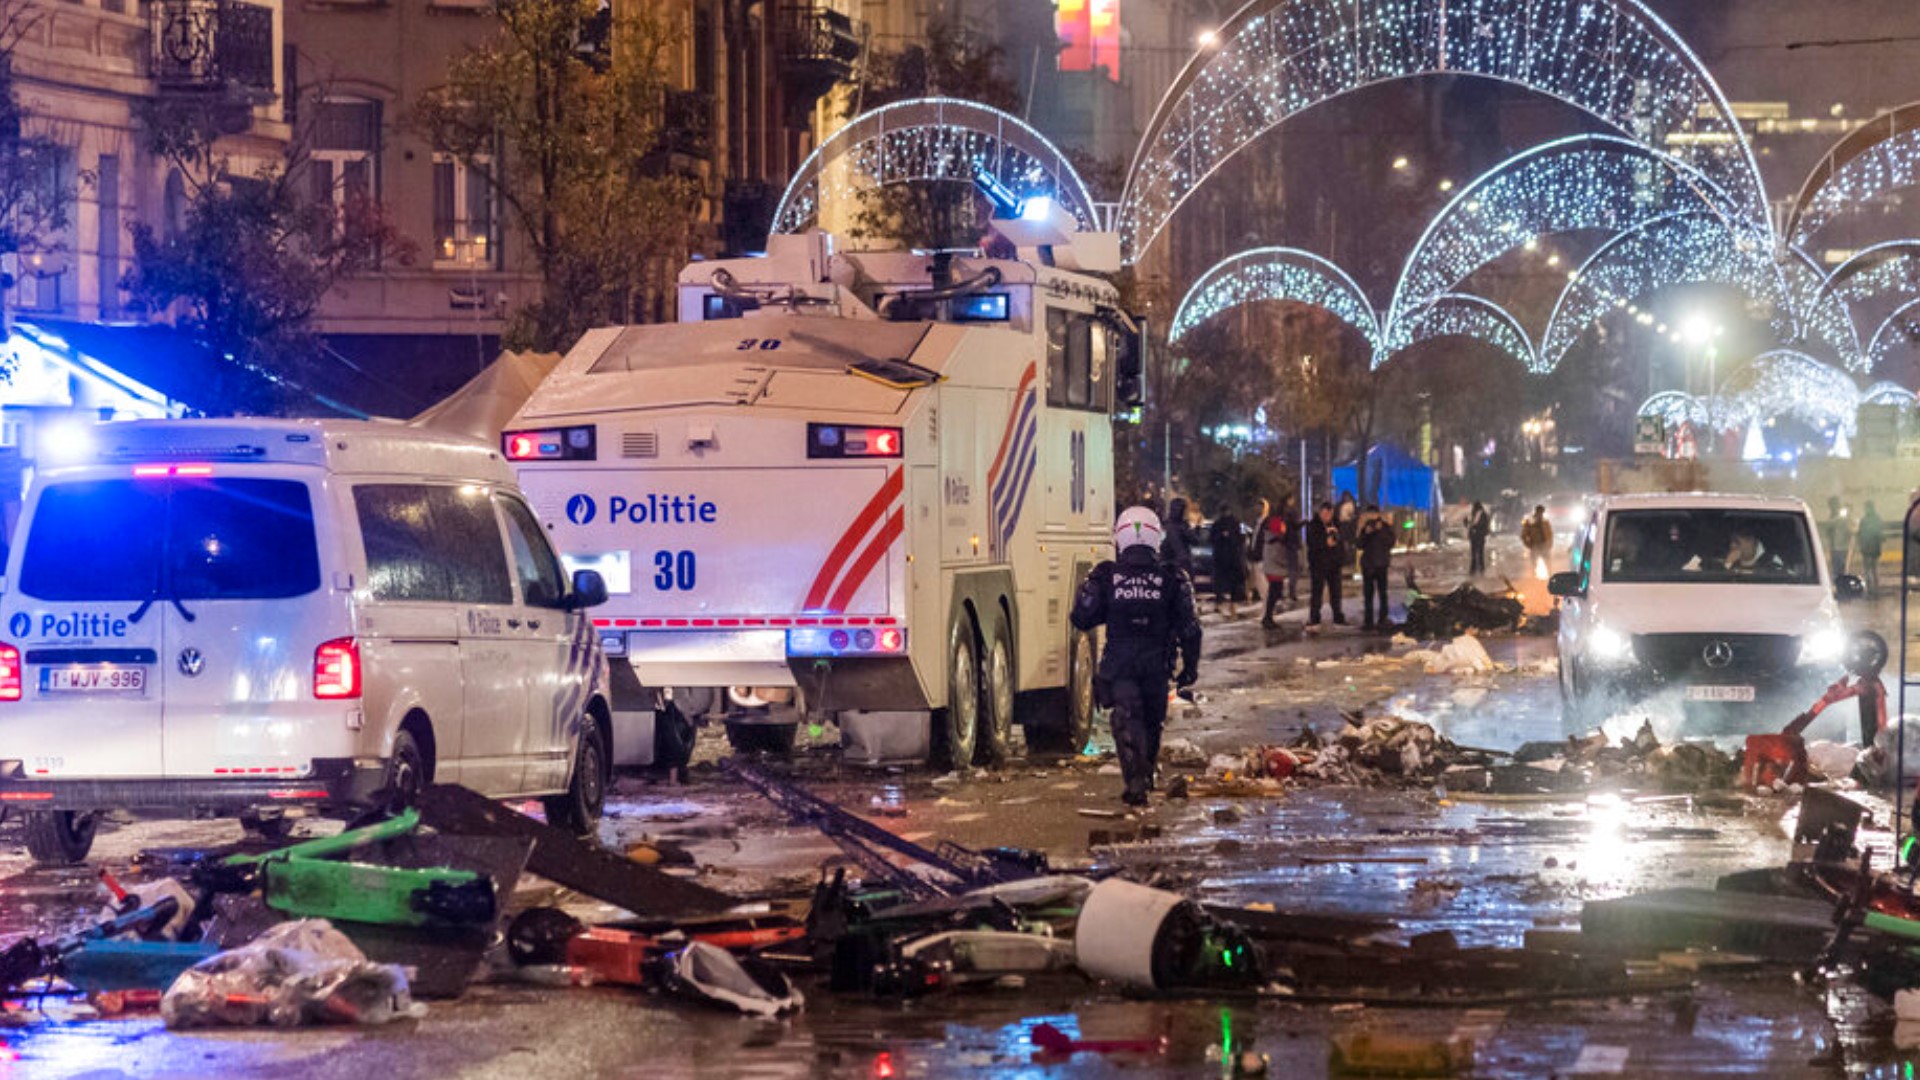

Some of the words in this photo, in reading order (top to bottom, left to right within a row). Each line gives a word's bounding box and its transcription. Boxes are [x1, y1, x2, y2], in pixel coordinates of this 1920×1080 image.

[609, 494, 717, 524] Politie
[655, 550, 696, 591] 30
[1115, 586, 1160, 599] Police
[41, 612, 127, 637] Politie
